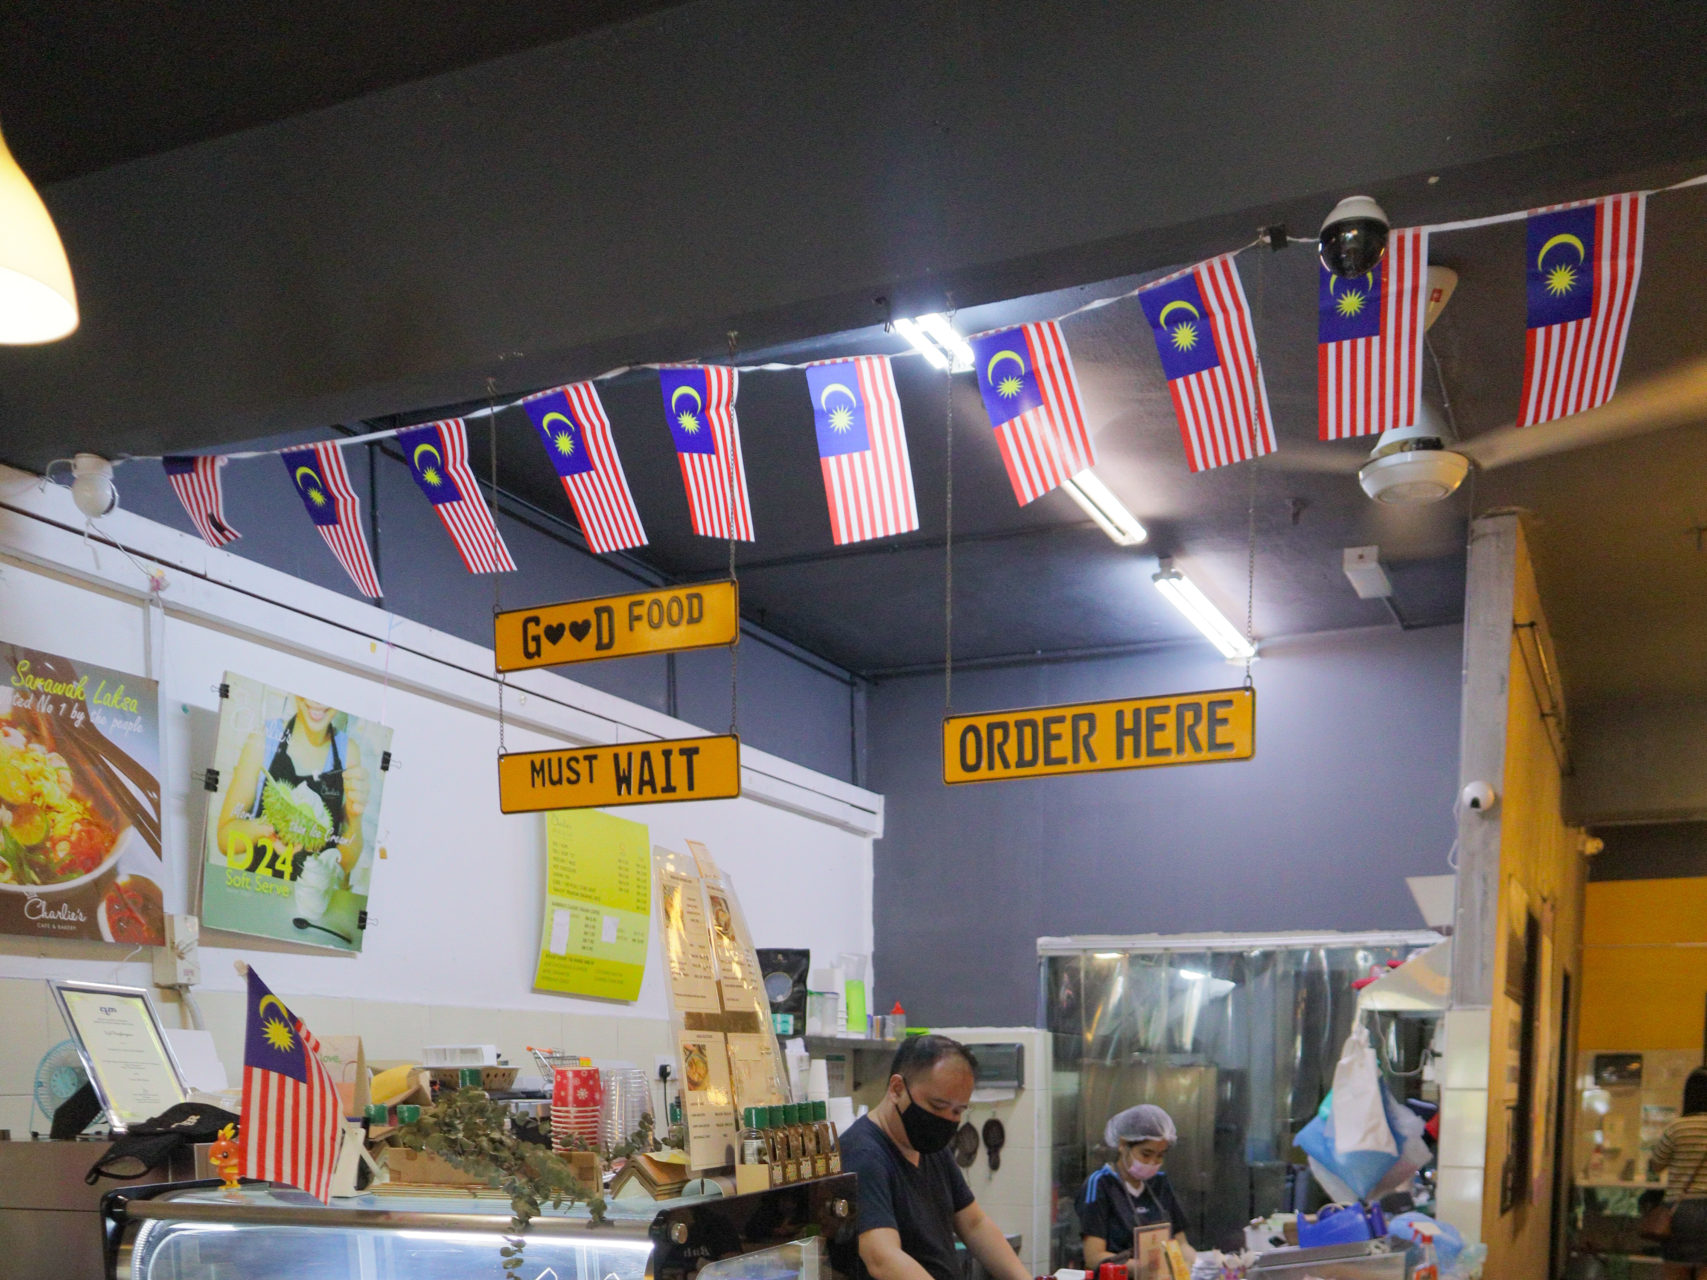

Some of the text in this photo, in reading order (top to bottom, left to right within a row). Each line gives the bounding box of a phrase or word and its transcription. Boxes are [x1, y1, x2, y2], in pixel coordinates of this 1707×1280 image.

[628, 593, 704, 631] FOOD
[10, 659, 139, 713] Sarawak Laksa
[36, 695, 54, 713] No
[59, 703, 67, 716] 1
[70, 703, 85, 728] by
[110, 716, 143, 735] people
[959, 700, 1235, 773] ORDER HERE
[530, 747, 700, 796] MUST WAIT
[226, 830, 293, 881] D24
[225, 869, 291, 897] Soft Serve
[24, 898, 87, 922] Charlie's
